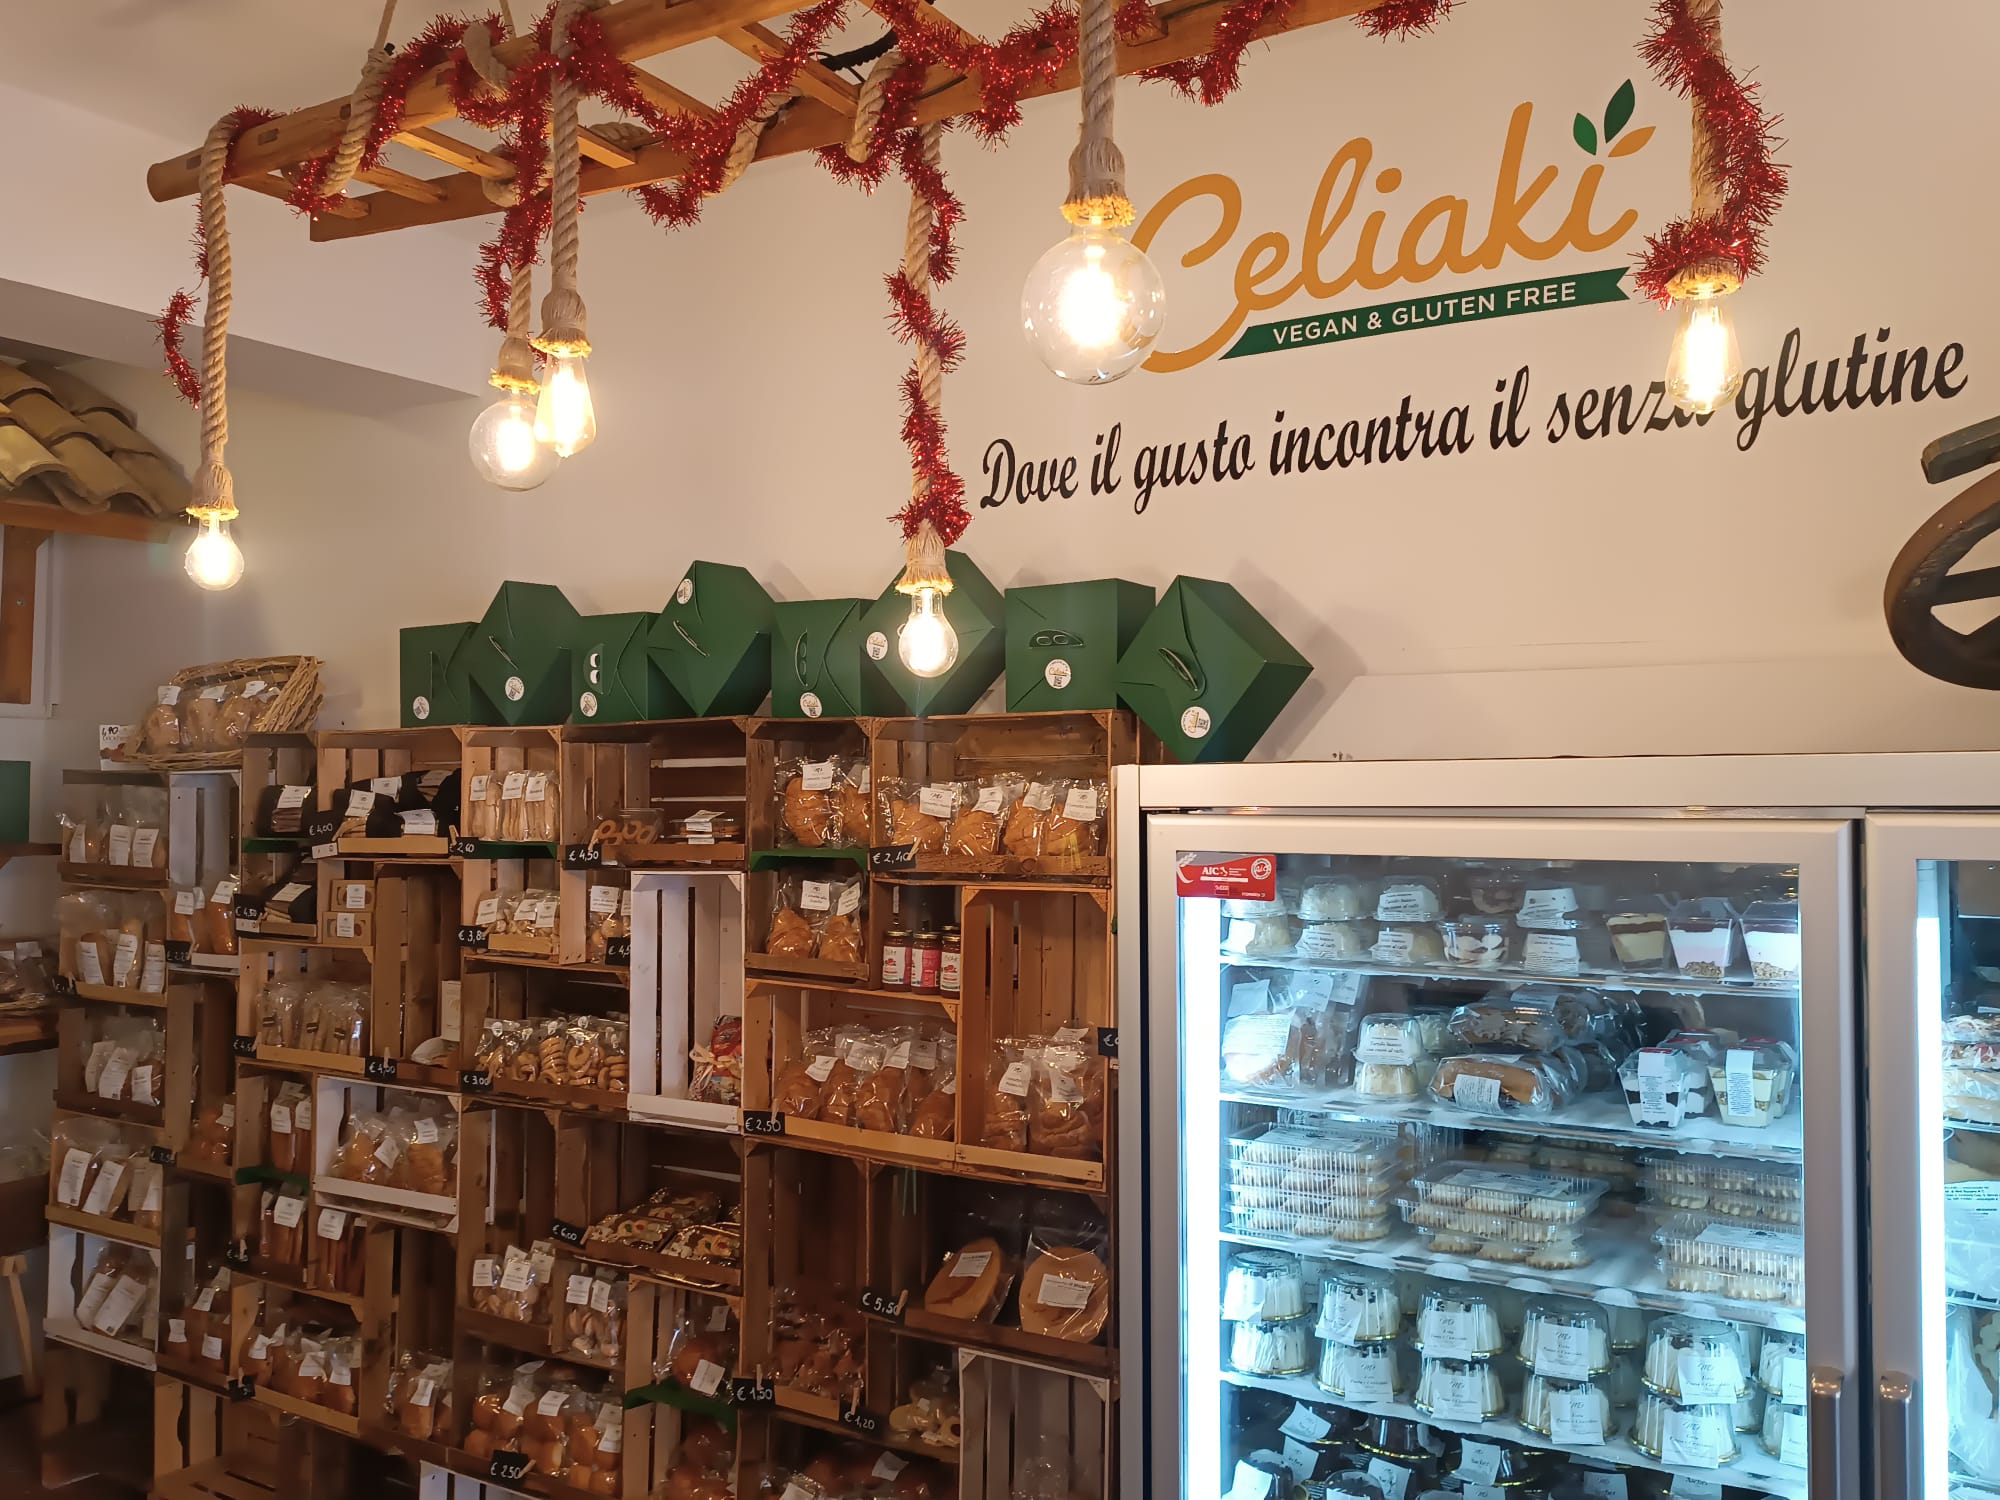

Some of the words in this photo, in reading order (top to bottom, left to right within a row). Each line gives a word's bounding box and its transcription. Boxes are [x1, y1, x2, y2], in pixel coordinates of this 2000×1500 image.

[1130, 102, 1638, 373] Celiaki
[1272, 316, 1357, 345] VEGAN
[1367, 311, 1382, 330] &
[1391, 294, 1495, 326] GLUTEN
[1507, 282, 1576, 309] FREE
[980, 439, 1078, 508] Dove
[1091, 423, 1121, 495] il
[1134, 421, 1255, 514] gusto
[1270, 396, 1474, 475] incontra
[1490, 366, 1530, 449] il
[1735, 326, 1968, 451] glutine
[579, 850, 598, 861] 4,50
